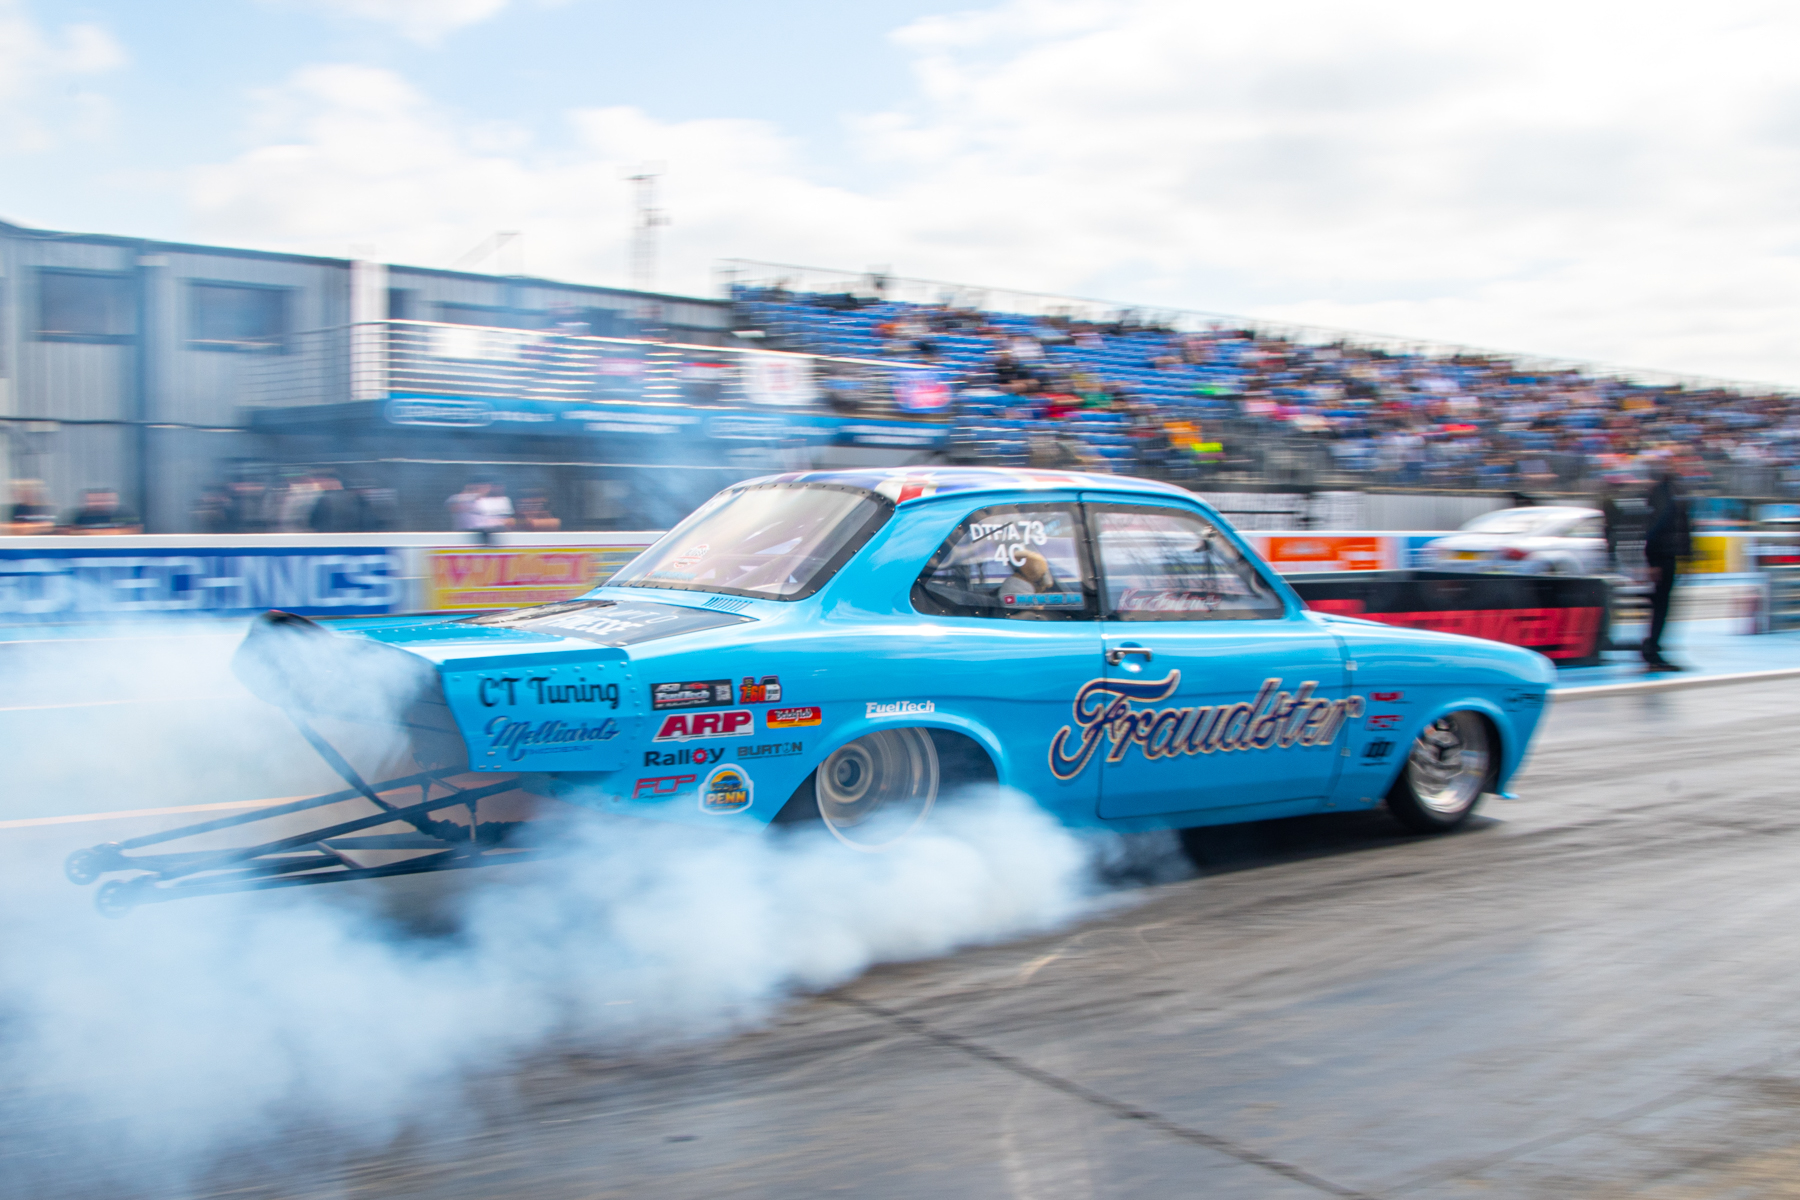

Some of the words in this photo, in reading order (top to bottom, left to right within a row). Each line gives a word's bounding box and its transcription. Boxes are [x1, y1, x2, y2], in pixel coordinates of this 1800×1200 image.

[1018, 521, 1048, 546] 73
[994, 543, 1028, 567] 4C
[479, 677, 523, 707] CT
[527, 677, 620, 709] Tuning
[865, 700, 936, 716] FuelTech
[656, 711, 752, 738] ARP
[1048, 669, 1366, 780] Fraudster
[705, 791, 747, 806] PENN
